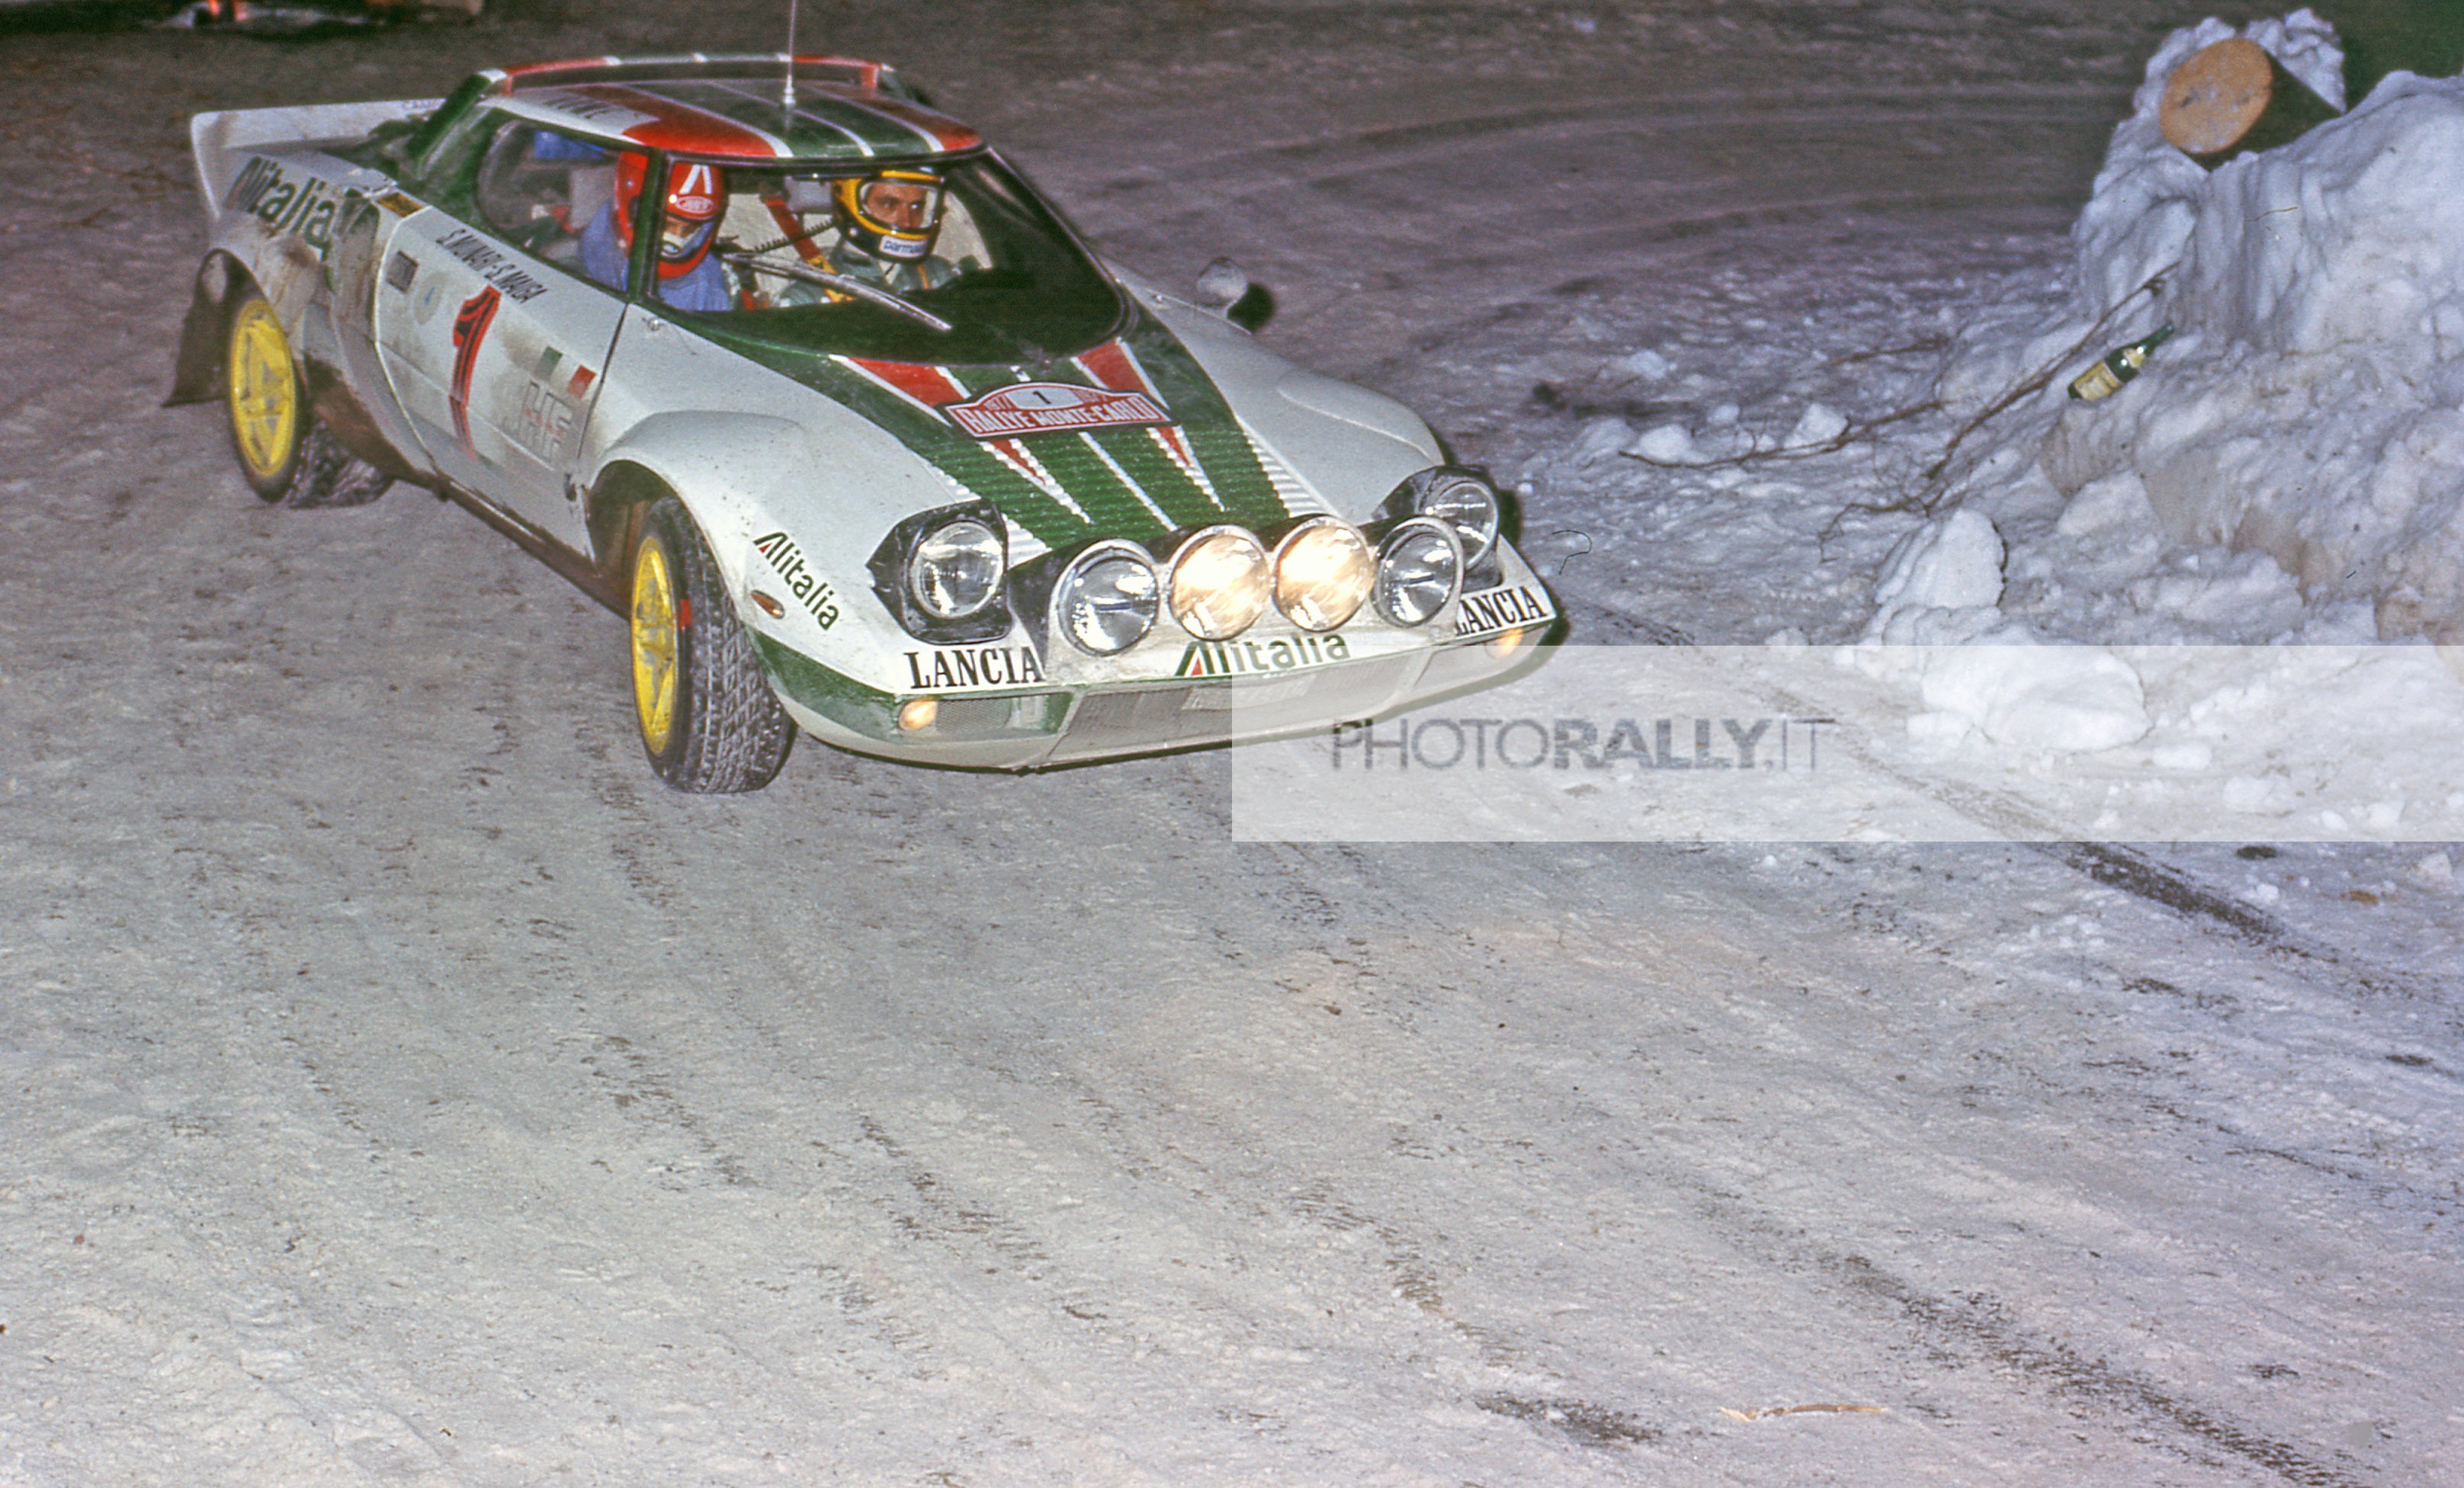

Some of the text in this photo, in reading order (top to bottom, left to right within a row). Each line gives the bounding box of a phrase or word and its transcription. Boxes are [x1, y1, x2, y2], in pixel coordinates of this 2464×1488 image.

[960, 396, 1160, 433] RALLYE MONTE-CARLO
[1032, 390, 1051, 405] 1
[754, 531, 840, 631] Alitalia
[903, 646, 1044, 689] LANCIA
[1173, 632, 1351, 676] Alitalia
